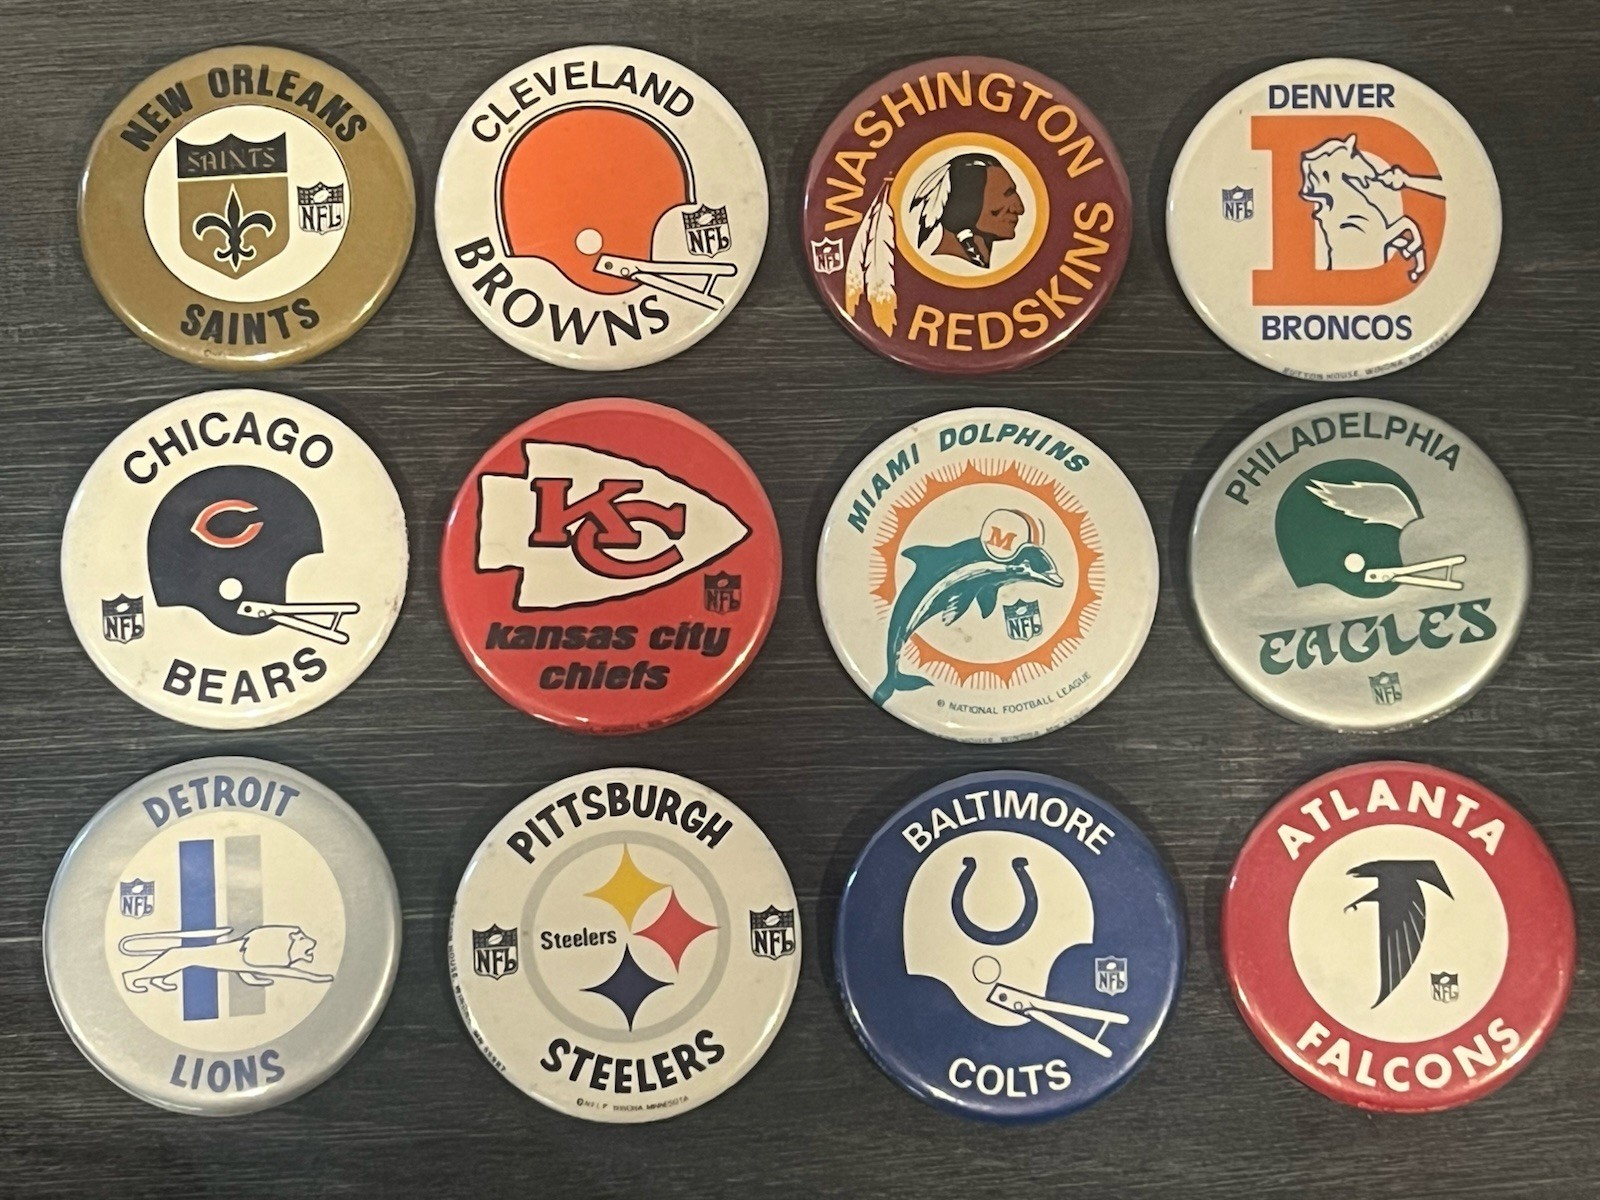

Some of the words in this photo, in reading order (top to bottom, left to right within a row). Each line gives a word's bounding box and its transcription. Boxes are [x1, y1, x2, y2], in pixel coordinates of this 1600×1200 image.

[121, 81, 193, 152] NEW
[208, 64, 367, 143] ORLEANS
[472, 61, 694, 142] CLEVELAND
[1269, 83, 1395, 109] DENVER
[188, 147, 275, 171] SAINTS
[825, 70, 1104, 232] WASHINGTON
[302, 205, 341, 230] NFL
[1224, 201, 1253, 219] NFL
[687, 226, 730, 254] NFL
[455, 236, 670, 345] BROWNS
[908, 202, 1115, 351] REDSKINS
[181, 298, 319, 345] SAINTS
[1262, 314, 1412, 341] BRONCOS
[123, 411, 334, 484] CHICAGO
[1225, 412, 1461, 505] PHILADELPHIA
[847, 442, 921, 534] MIAMI
[939, 423, 1091, 473] DOLPHINS
[191, 499, 264, 548] C
[528, 477, 687, 579] KC
[986, 526, 1017, 551] M
[705, 589, 741, 611] NFL
[105, 615, 144, 639] NFL
[485, 621, 638, 650] kansas
[649, 621, 731, 657] city
[1008, 616, 1042, 640] NFL
[1258, 597, 1497, 675] EAGLES
[163, 647, 327, 705] BEARS
[539, 660, 671, 690] chiefs
[949, 701, 998, 714] NATIONAL
[1002, 694, 1054, 713] FOOTBALL
[1056, 671, 1091, 699] LEAGUE
[1373, 685, 1403, 704] NFL
[142, 775, 300, 828] DETROIT
[901, 789, 1116, 855] BALTIMORE
[1277, 778, 1505, 861] ATLANTA
[506, 782, 734, 865] PITTSBURGH
[121, 894, 153, 916] NFL
[540, 927, 617, 950] Steelers
[754, 928, 795, 958] NFL
[474, 947, 518, 978] NFL
[1097, 971, 1126, 991] NFL
[169, 1049, 285, 1093] LIONS
[539, 1029, 726, 1094] STEELERS
[1296, 1017, 1520, 1092] FALCONS
[948, 1057, 1072, 1098] COLTS
